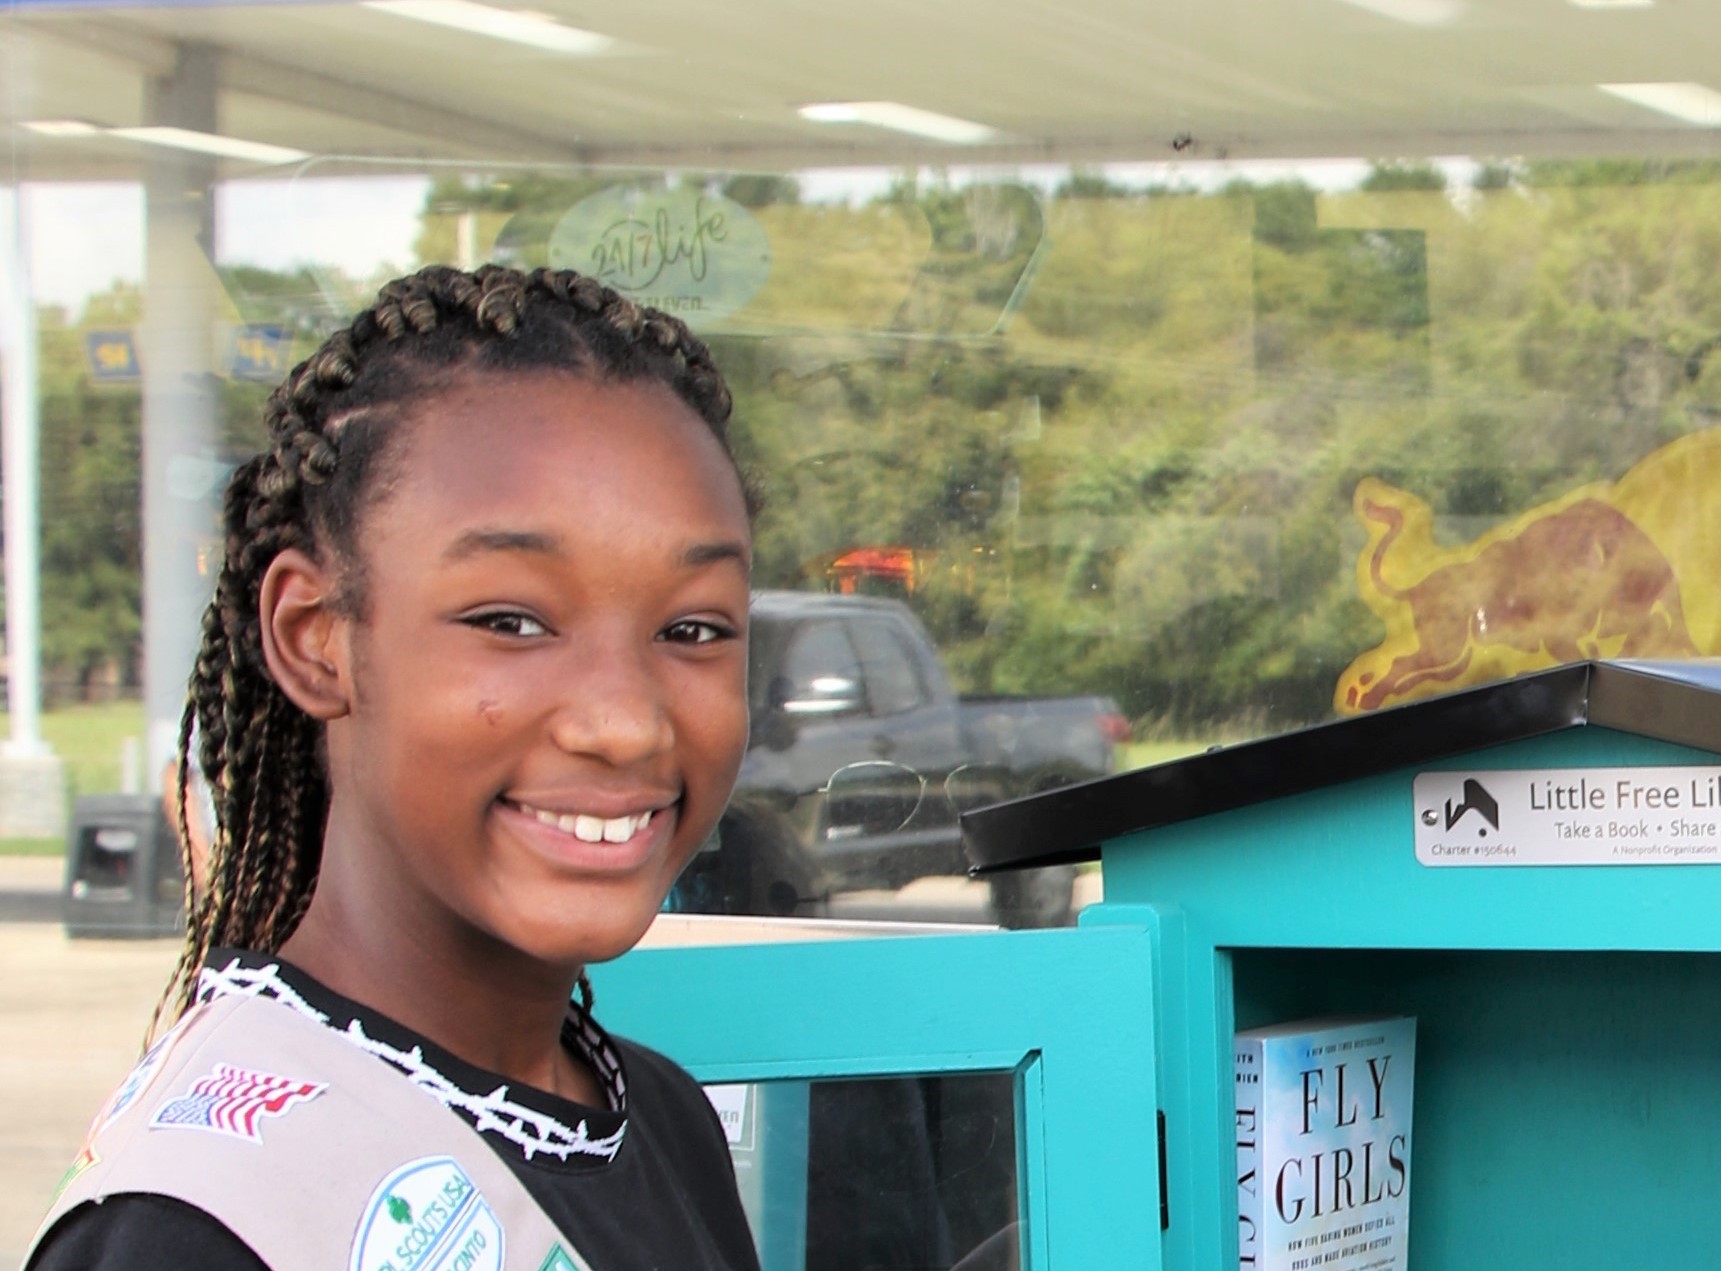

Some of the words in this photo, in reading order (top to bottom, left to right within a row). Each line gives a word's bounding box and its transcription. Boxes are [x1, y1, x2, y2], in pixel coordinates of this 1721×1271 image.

[655, 197, 729, 283] life
[1529, 778, 1605, 811] Little
[1616, 781, 1680, 809] Free
[1554, 820, 1591, 839] Take
[1595, 825, 1604, 838] a
[1608, 820, 1648, 838] Book
[1669, 817, 1716, 837] Share
[1431, 843, 1472, 856] Charter
[1612, 845, 1619, 855] A
[1620, 844, 1662, 857] Nonprofit
[1663, 844, 1718, 856] Organization
[1236, 1054, 1253, 1064] ITH
[1299, 1054, 1393, 1136] FLY
[1275, 1134, 1406, 1225] GIRLS
[396, 1200, 449, 1266] SCOUTS
[438, 1174, 472, 1208] USA
